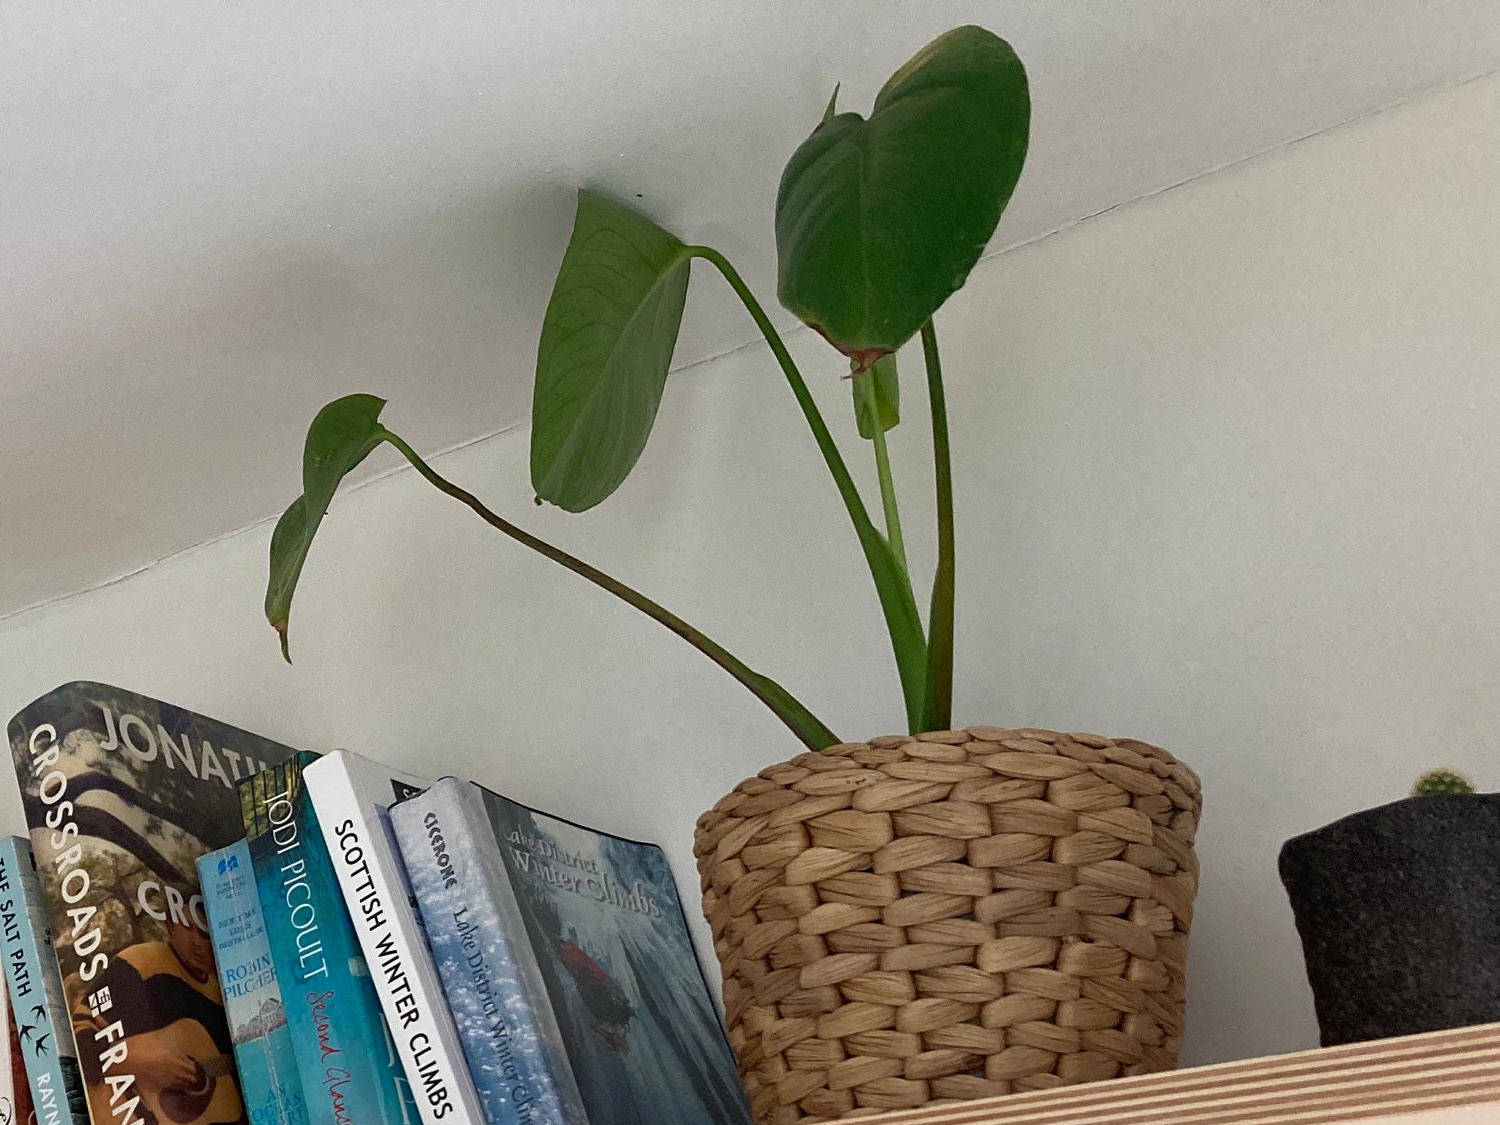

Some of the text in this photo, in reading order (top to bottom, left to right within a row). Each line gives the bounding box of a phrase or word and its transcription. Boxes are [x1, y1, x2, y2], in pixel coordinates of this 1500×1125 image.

[100, 707, 267, 789] JONAT
[29, 723, 109, 982] CROSSROADS
[262, 790, 328, 980] JODI PICOULT
[423, 812, 458, 890] CICERONE
[509, 847, 581, 892] Winter
[0, 899, 20, 943] SALT
[10, 949, 32, 997] PATH
[334, 818, 387, 932] SCOTTISH
[375, 932, 420, 1030] WINTER
[409, 1032, 453, 1120] CLIMBS
[453, 905, 476, 951] Lake
[467, 951, 499, 1019] District
[490, 1019, 520, 1082] Winter
[306, 990, 342, 1064] Second
